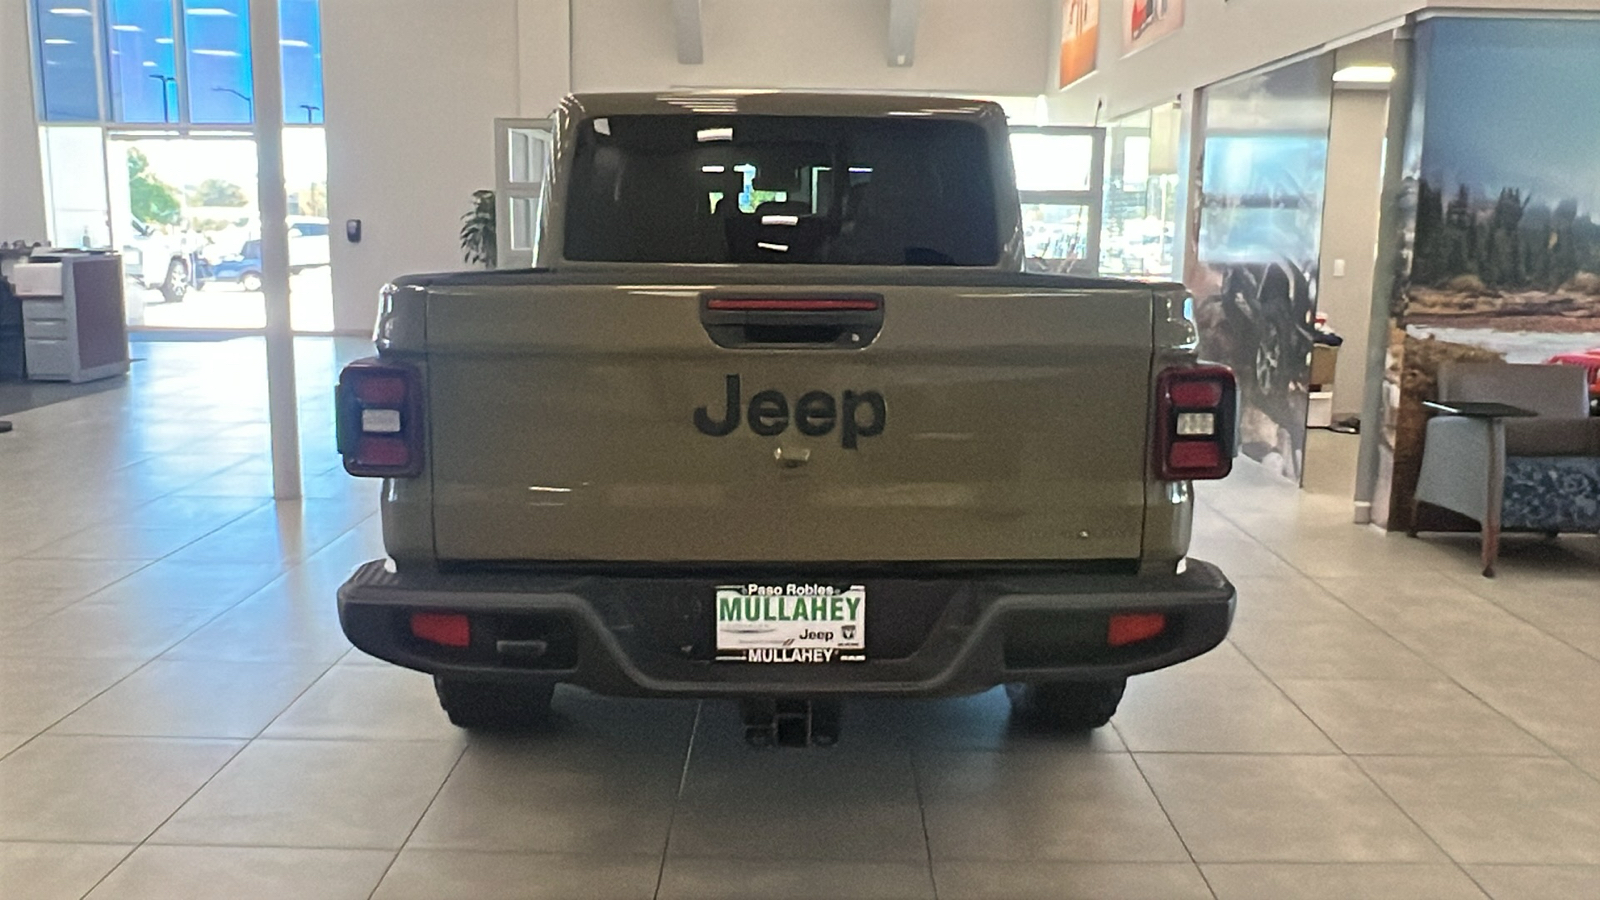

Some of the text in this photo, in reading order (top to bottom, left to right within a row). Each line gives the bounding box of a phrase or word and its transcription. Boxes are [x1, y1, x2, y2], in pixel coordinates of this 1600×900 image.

[693, 373, 886, 450] Jeep
[748, 583, 834, 596] Paso Robles
[719, 597, 861, 621] MULLAHEY
[799, 628, 834, 642] Jeep
[748, 648, 833, 663] MULLAHEY
